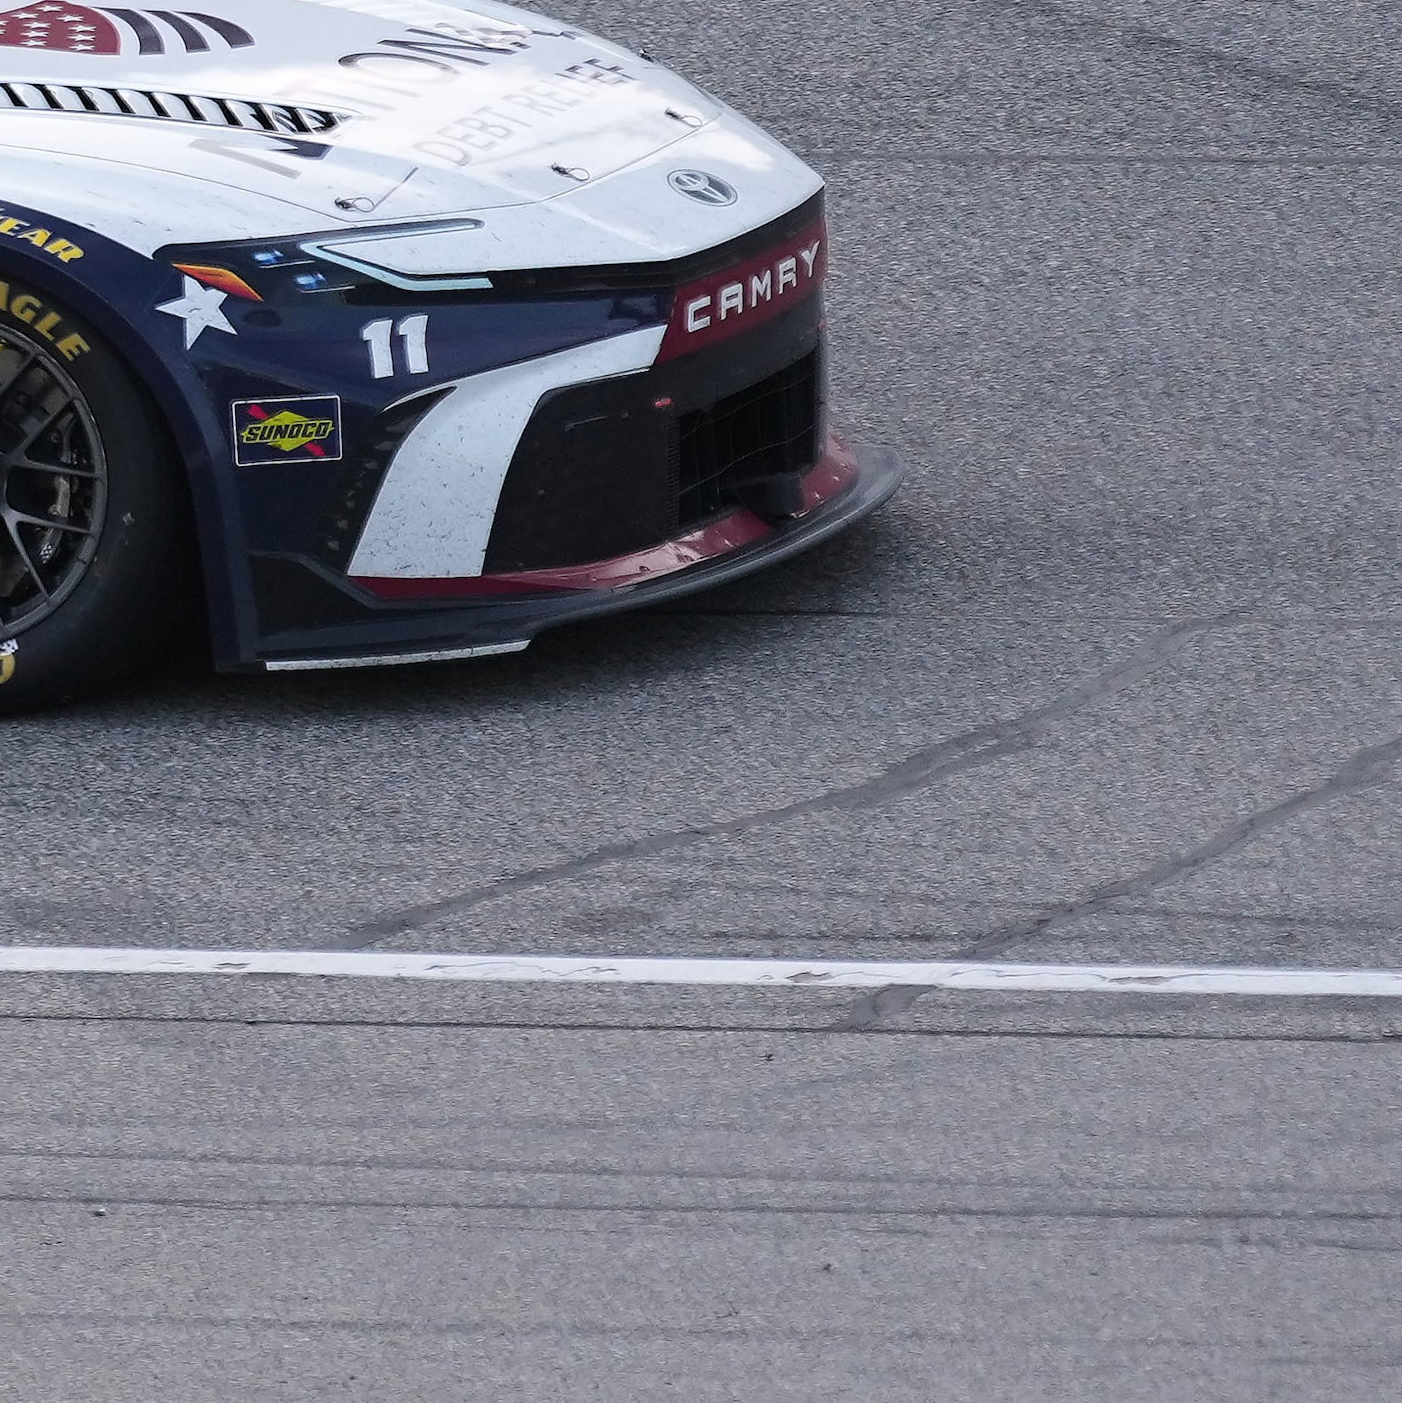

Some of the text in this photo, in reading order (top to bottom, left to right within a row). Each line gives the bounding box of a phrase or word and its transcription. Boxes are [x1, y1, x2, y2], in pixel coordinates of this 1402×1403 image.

[685, 240, 821, 333] CAMRY
[362, 314, 430, 379] 11
[245, 422, 331, 443] SUNOCO
